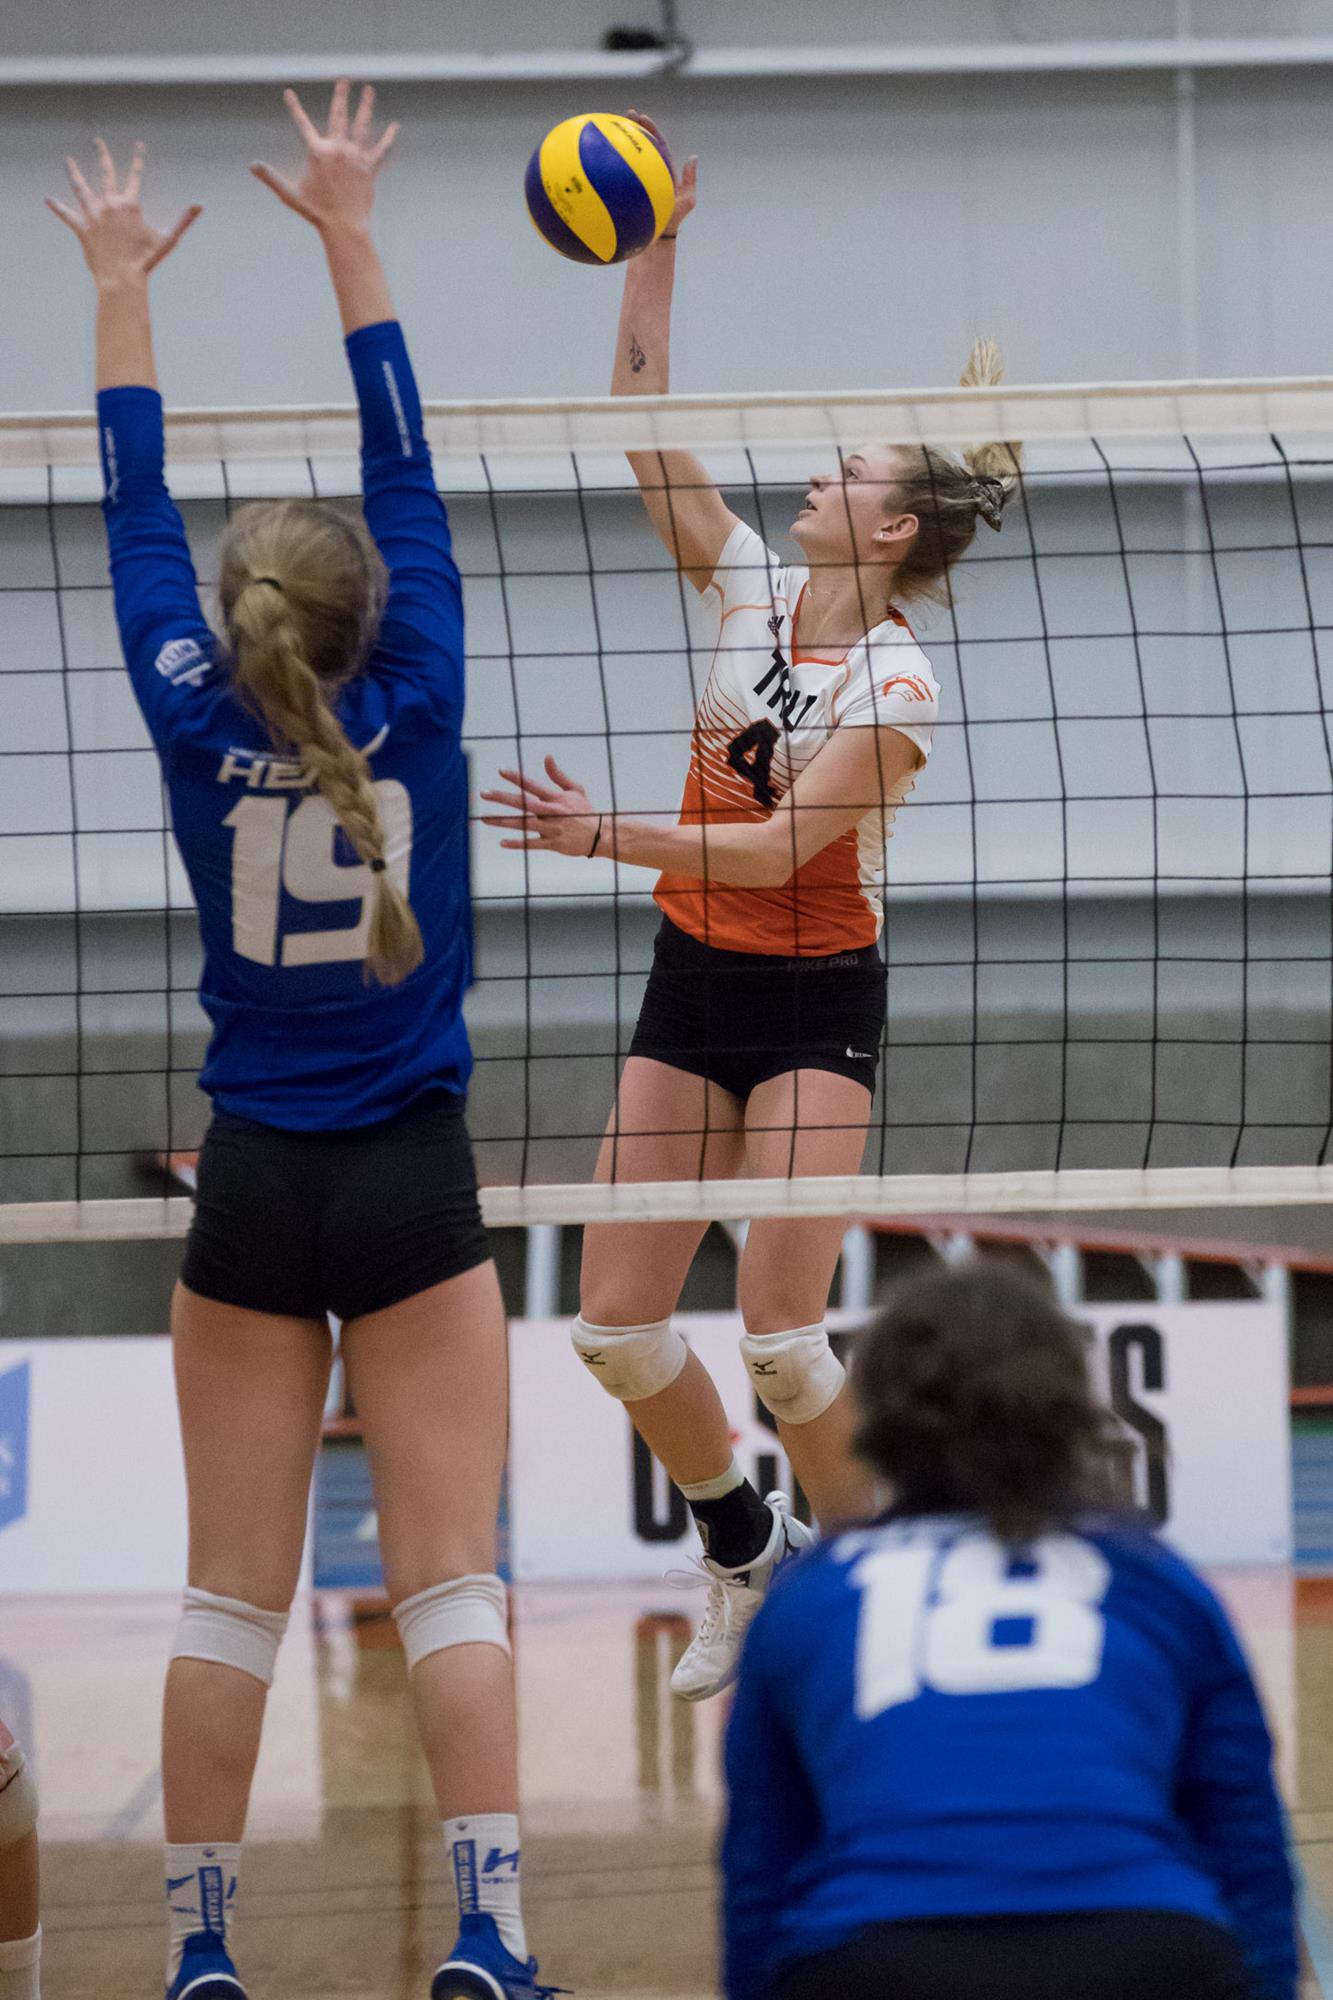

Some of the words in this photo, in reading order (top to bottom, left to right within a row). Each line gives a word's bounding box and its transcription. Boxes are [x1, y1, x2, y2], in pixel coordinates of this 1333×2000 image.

[752, 649, 818, 733] TRU
[727, 717, 781, 808] 4
[221, 795, 413, 967] 19
[848, 1538, 1111, 1721] 18
